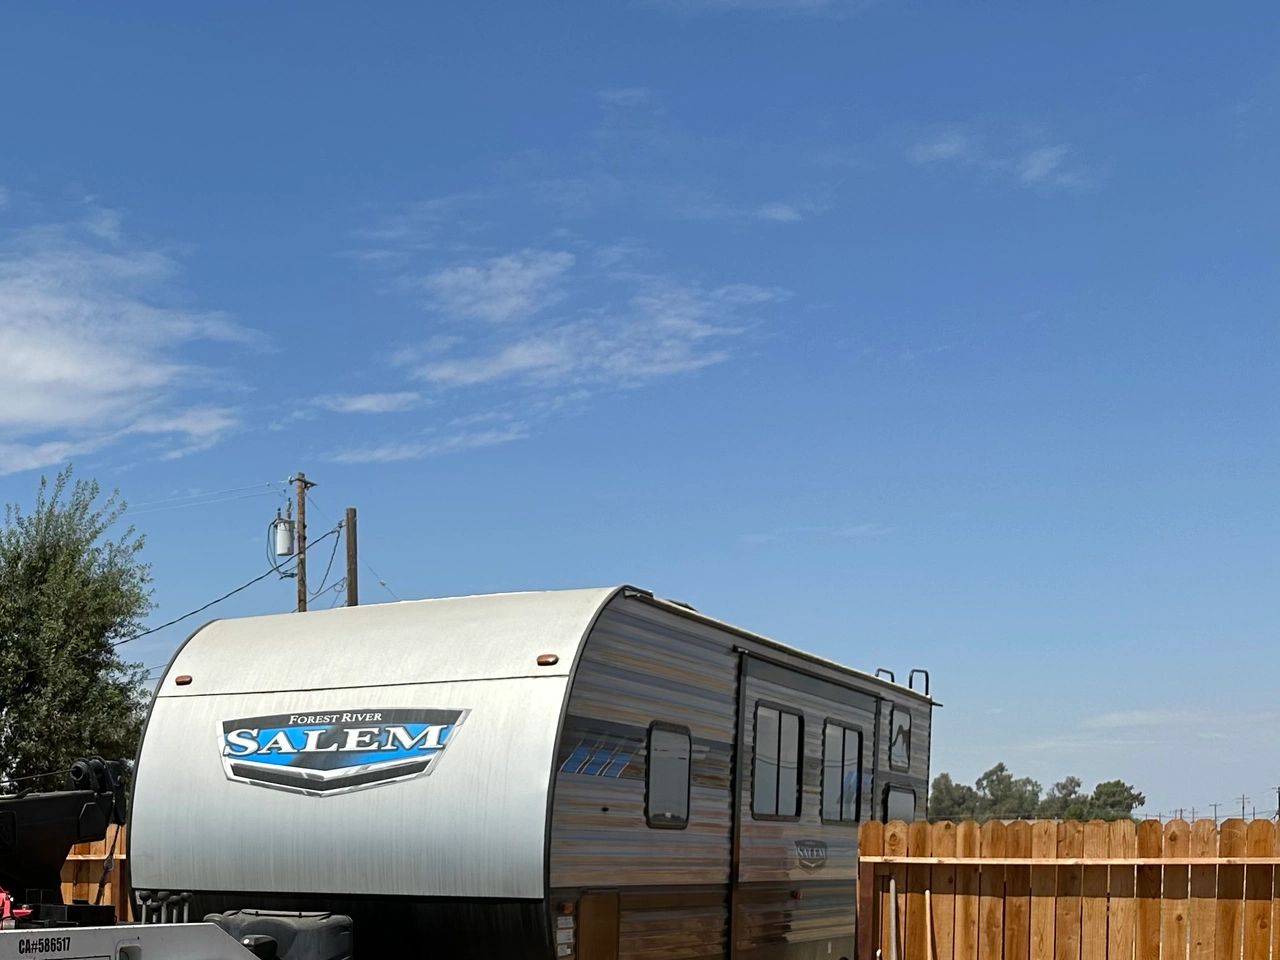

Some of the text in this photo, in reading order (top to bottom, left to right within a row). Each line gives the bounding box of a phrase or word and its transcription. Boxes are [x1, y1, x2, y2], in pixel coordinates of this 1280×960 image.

[288, 712, 382, 725] FOREST RIVER
[223, 724, 447, 757] SALEM
[18, 936, 71, 955] CA#586517
